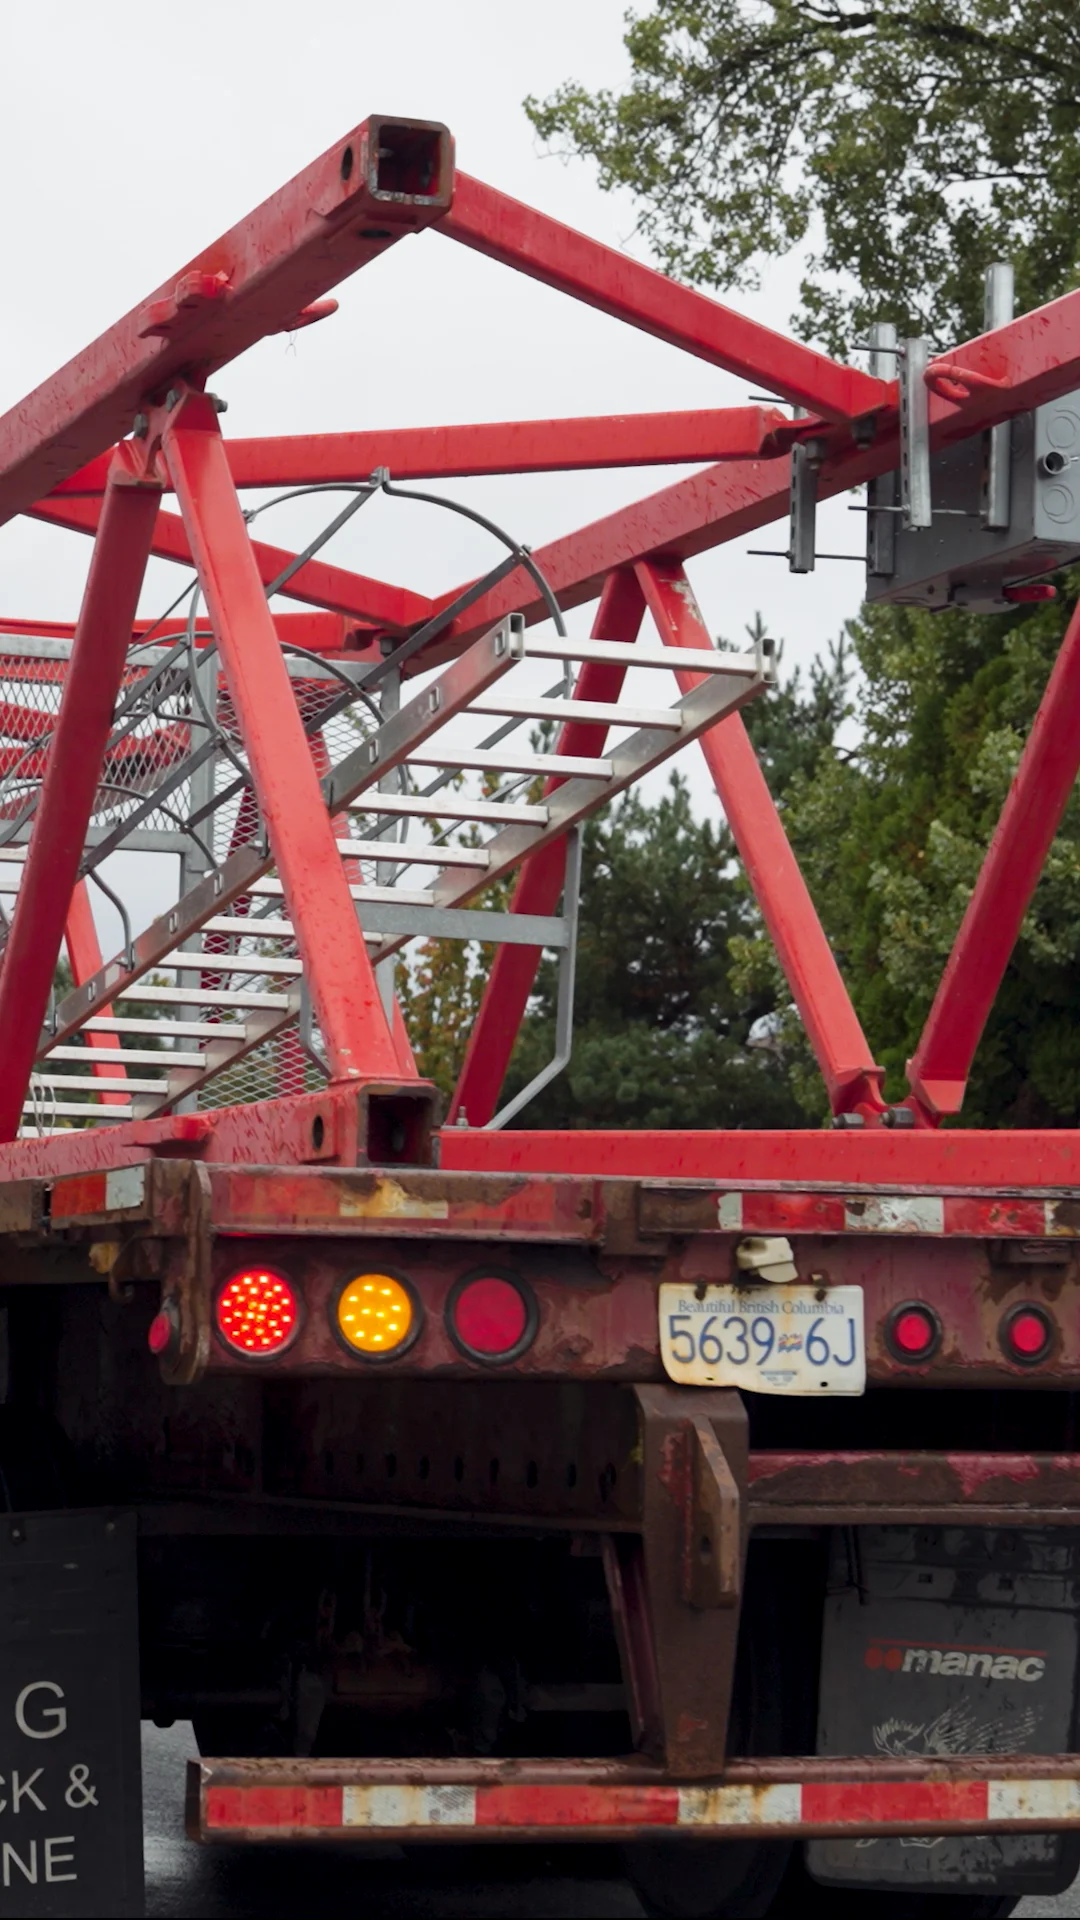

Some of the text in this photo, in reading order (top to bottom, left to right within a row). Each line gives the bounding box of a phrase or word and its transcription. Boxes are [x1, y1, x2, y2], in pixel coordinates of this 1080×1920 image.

[678, 1299, 845, 1315] Beautiful British Columbia
[668, 1315, 856, 1366] 5639 6J
[901, 1648, 1046, 1682] manac
[15, 1680, 67, 1739] G
[0, 1763, 99, 1814] K &
